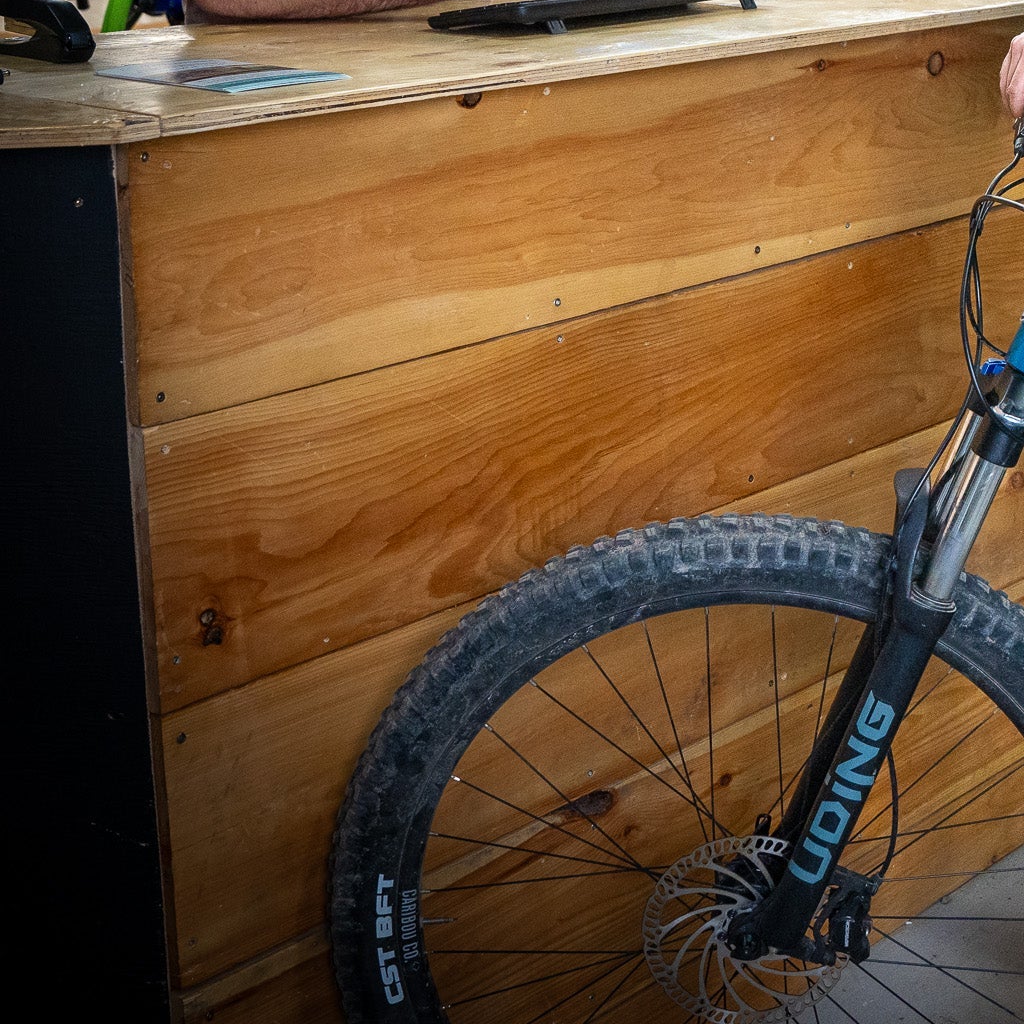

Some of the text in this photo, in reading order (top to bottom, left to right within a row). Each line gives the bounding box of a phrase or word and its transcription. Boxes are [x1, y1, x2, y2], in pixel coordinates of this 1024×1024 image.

[787, 689, 896, 885] UDING
[375, 873, 405, 1005] CST BFT
[400, 888, 418, 940] CARIBOU
